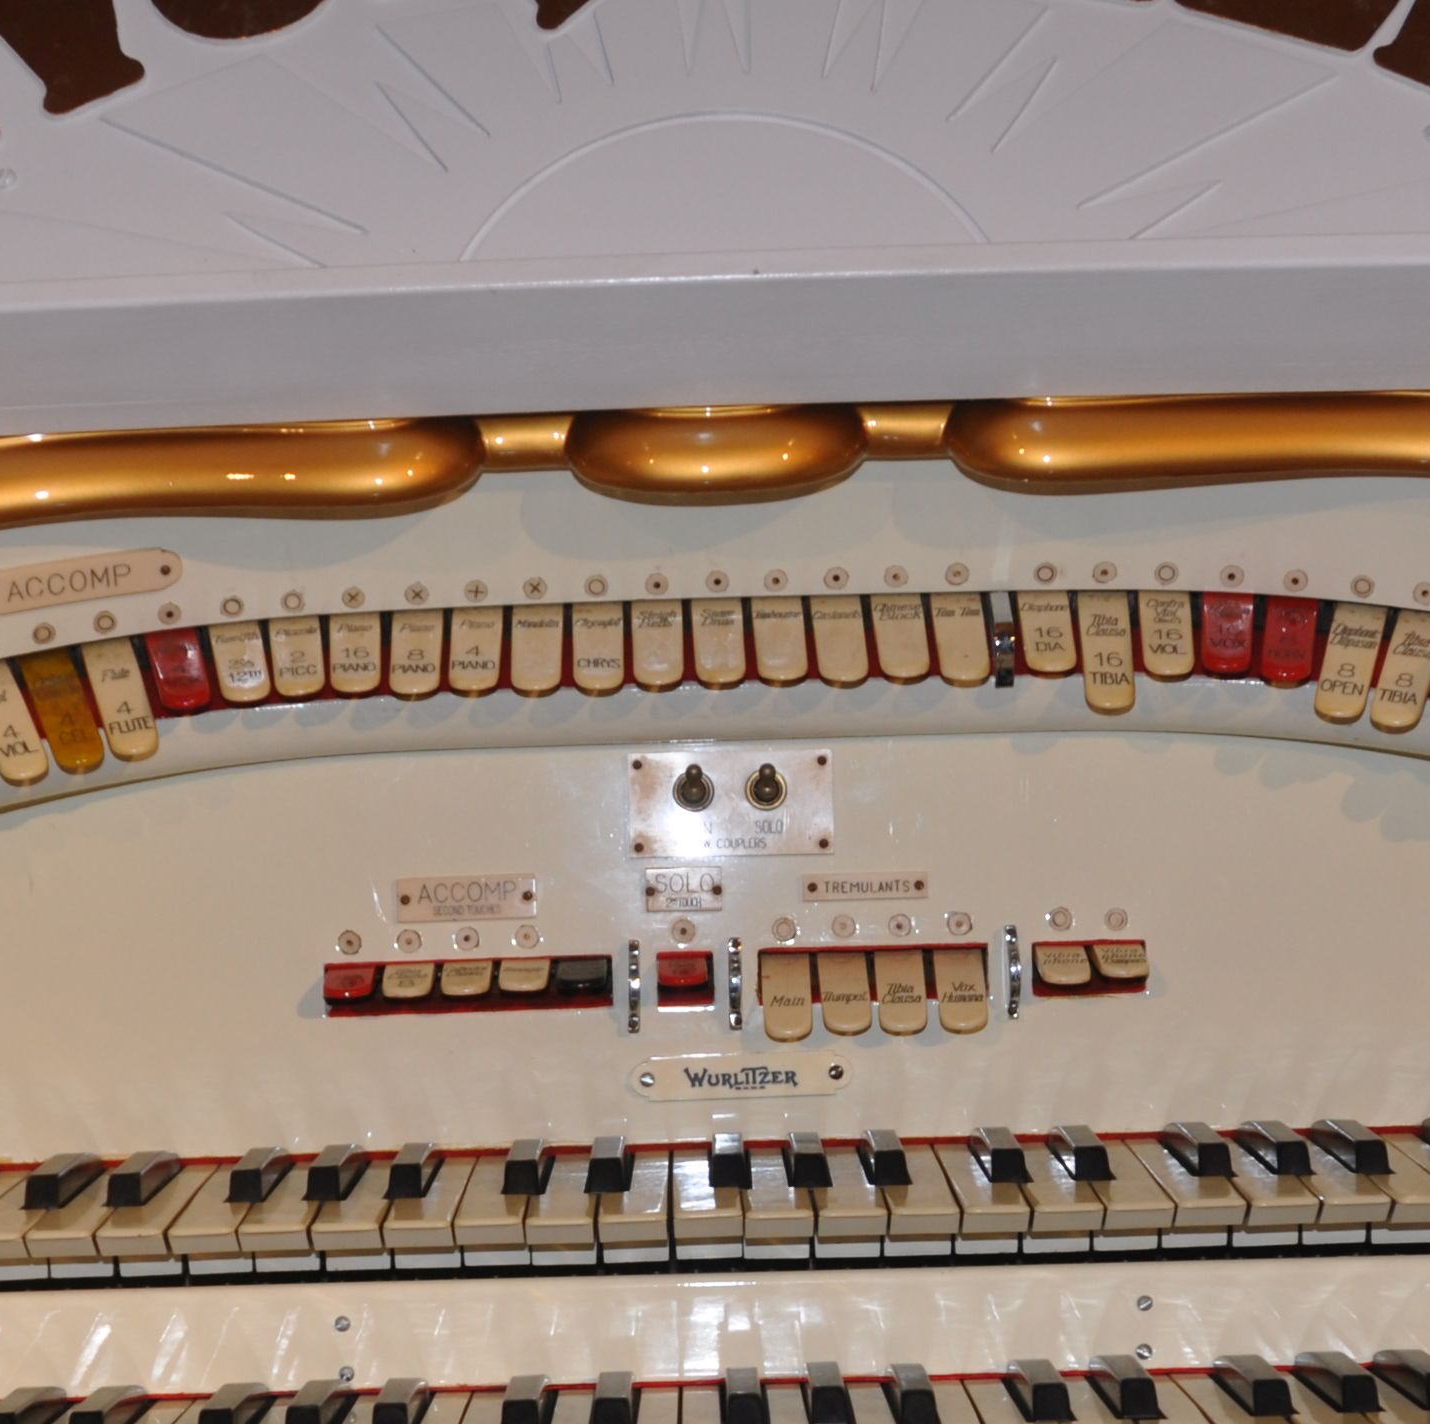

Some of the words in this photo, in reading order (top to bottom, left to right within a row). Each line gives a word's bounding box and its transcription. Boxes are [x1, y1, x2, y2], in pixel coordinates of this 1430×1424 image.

[6, 562, 132, 604] ACCOMP
[1145, 598, 1187, 611] Contra
[934, 606, 956, 618] Tom
[959, 606, 981, 617] Tom
[1154, 607, 1180, 618] Viol
[459, 617, 496, 630] Piano
[1090, 613, 1120, 626] Tibia
[337, 622, 373, 634] Piano
[399, 622, 436, 634] Piano
[1033, 626, 1063, 640] 16
[1085, 624, 1127, 638] Clausa
[1153, 627, 1184, 641] 16
[340, 646, 371, 660] 16
[465, 645, 481, 657] 4
[1035, 640, 1066, 653] DIA
[1147, 643, 1188, 656] VIOL
[290, 650, 306, 664] 2
[406, 648, 425, 661] 8
[1093, 651, 1124, 668] 16
[332, 662, 377, 674] PIANO
[391, 662, 436, 675] PIANO
[451, 658, 496, 672] PIANO
[576, 656, 621, 670] CHRYS
[101, 667, 131, 683] Flute
[279, 663, 318, 678] PICC
[1337, 662, 1356, 679] 8
[1088, 670, 1132, 686] TIBIA
[1395, 672, 1414, 688] 8
[1319, 677, 1366, 697] OPEN
[1378, 687, 1419, 707] TIBIA
[116, 700, 135, 715] 4
[2, 724, 19, 739] 4
[108, 715, 154, 736] FLUTE
[754, 819, 785, 835] SOLO
[716, 837, 768, 850] COUPLERS
[654, 872, 716, 895] SOLO
[823, 879, 912, 894] TREMULANTS
[417, 879, 518, 905] ACCOMP
[886, 982, 915, 994] Tibia
[951, 981, 977, 992] Vox
[770, 994, 806, 1008] Main
[822, 990, 869, 1006] Trumpet
[881, 992, 923, 1005] Clausa
[941, 991, 985, 1005] Humana
